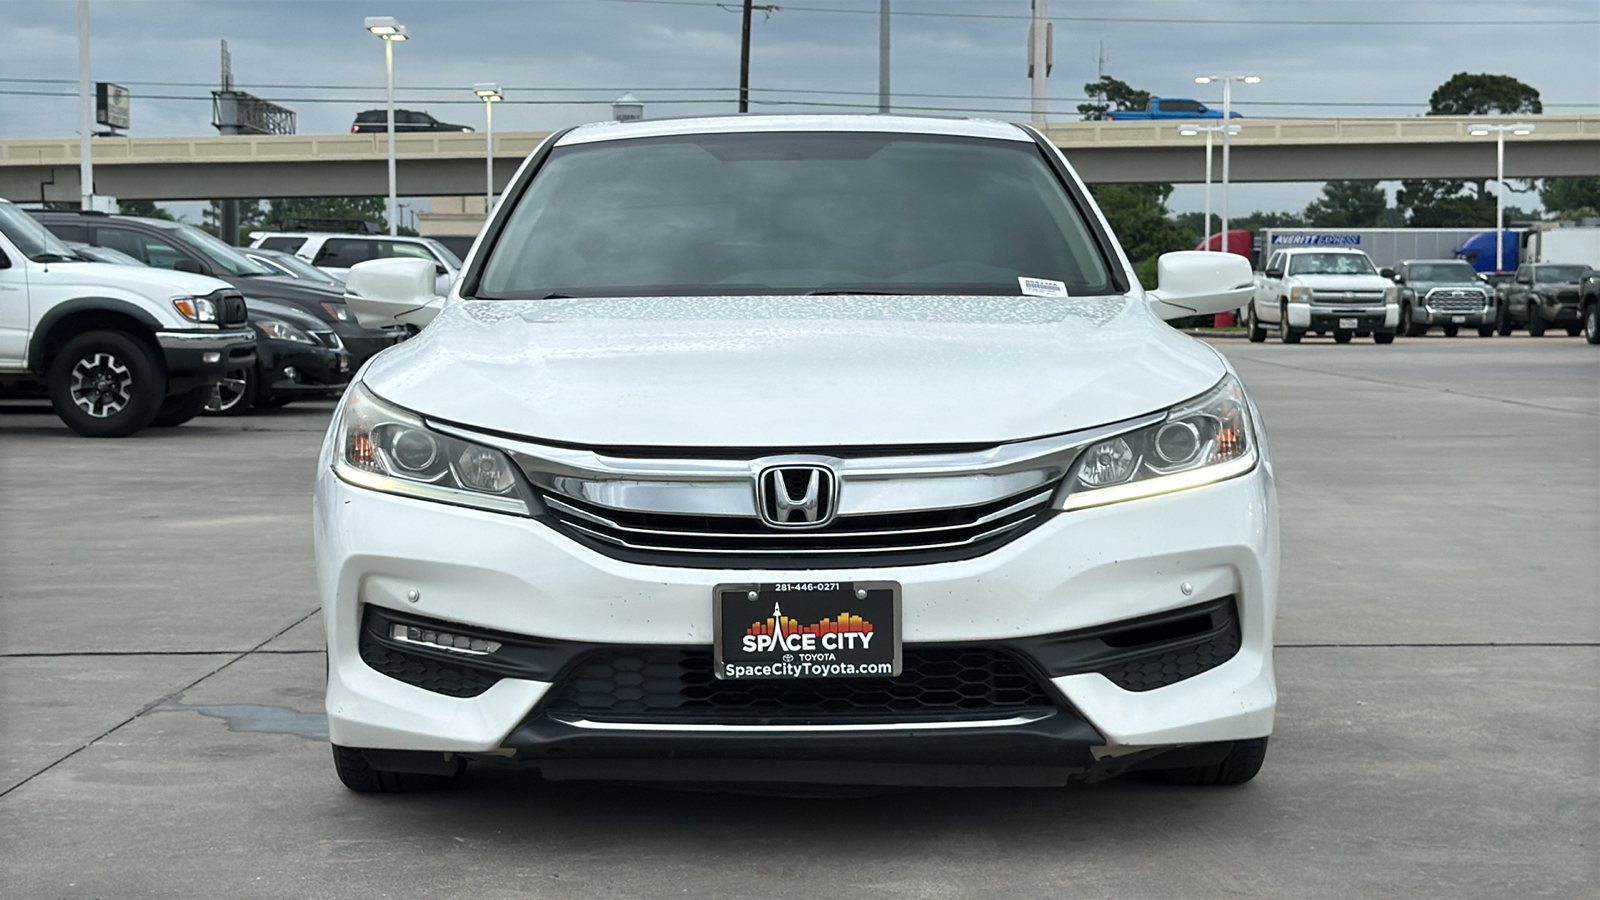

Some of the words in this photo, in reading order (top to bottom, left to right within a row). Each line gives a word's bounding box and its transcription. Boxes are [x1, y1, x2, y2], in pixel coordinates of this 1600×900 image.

[1274, 234, 1318, 244] AVERITT
[775, 583, 840, 592] 281-446-0271
[742, 632, 816, 652] SPACE
[821, 631, 874, 650] CITY
[799, 653, 836, 661] TOYOTA
[725, 662, 892, 678] SpaceCityToyota.com
